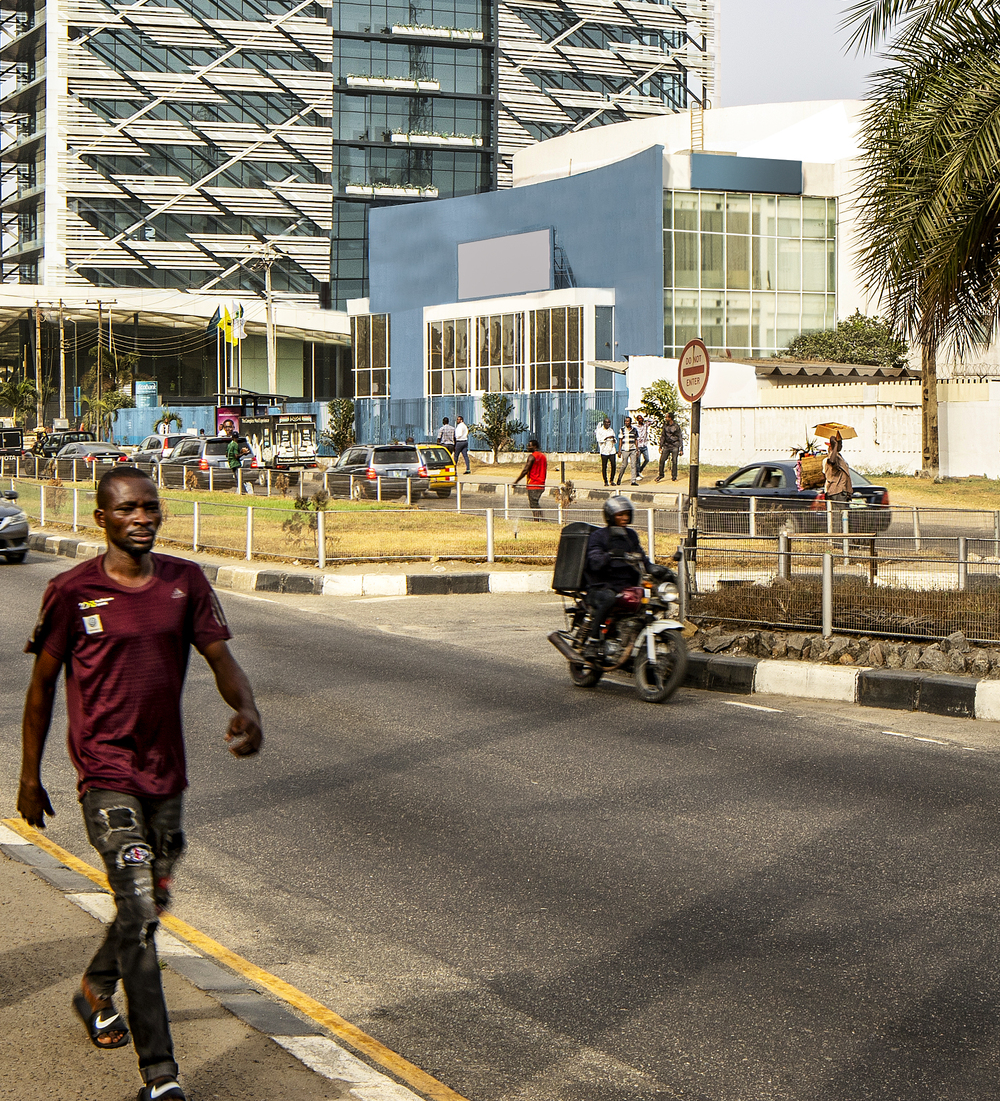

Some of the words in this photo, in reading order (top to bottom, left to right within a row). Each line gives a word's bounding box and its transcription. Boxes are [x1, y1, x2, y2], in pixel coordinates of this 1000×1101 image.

[686, 357, 691, 365] DO
[694, 355, 702, 363] NOT
[686, 377, 700, 386] ENTER
